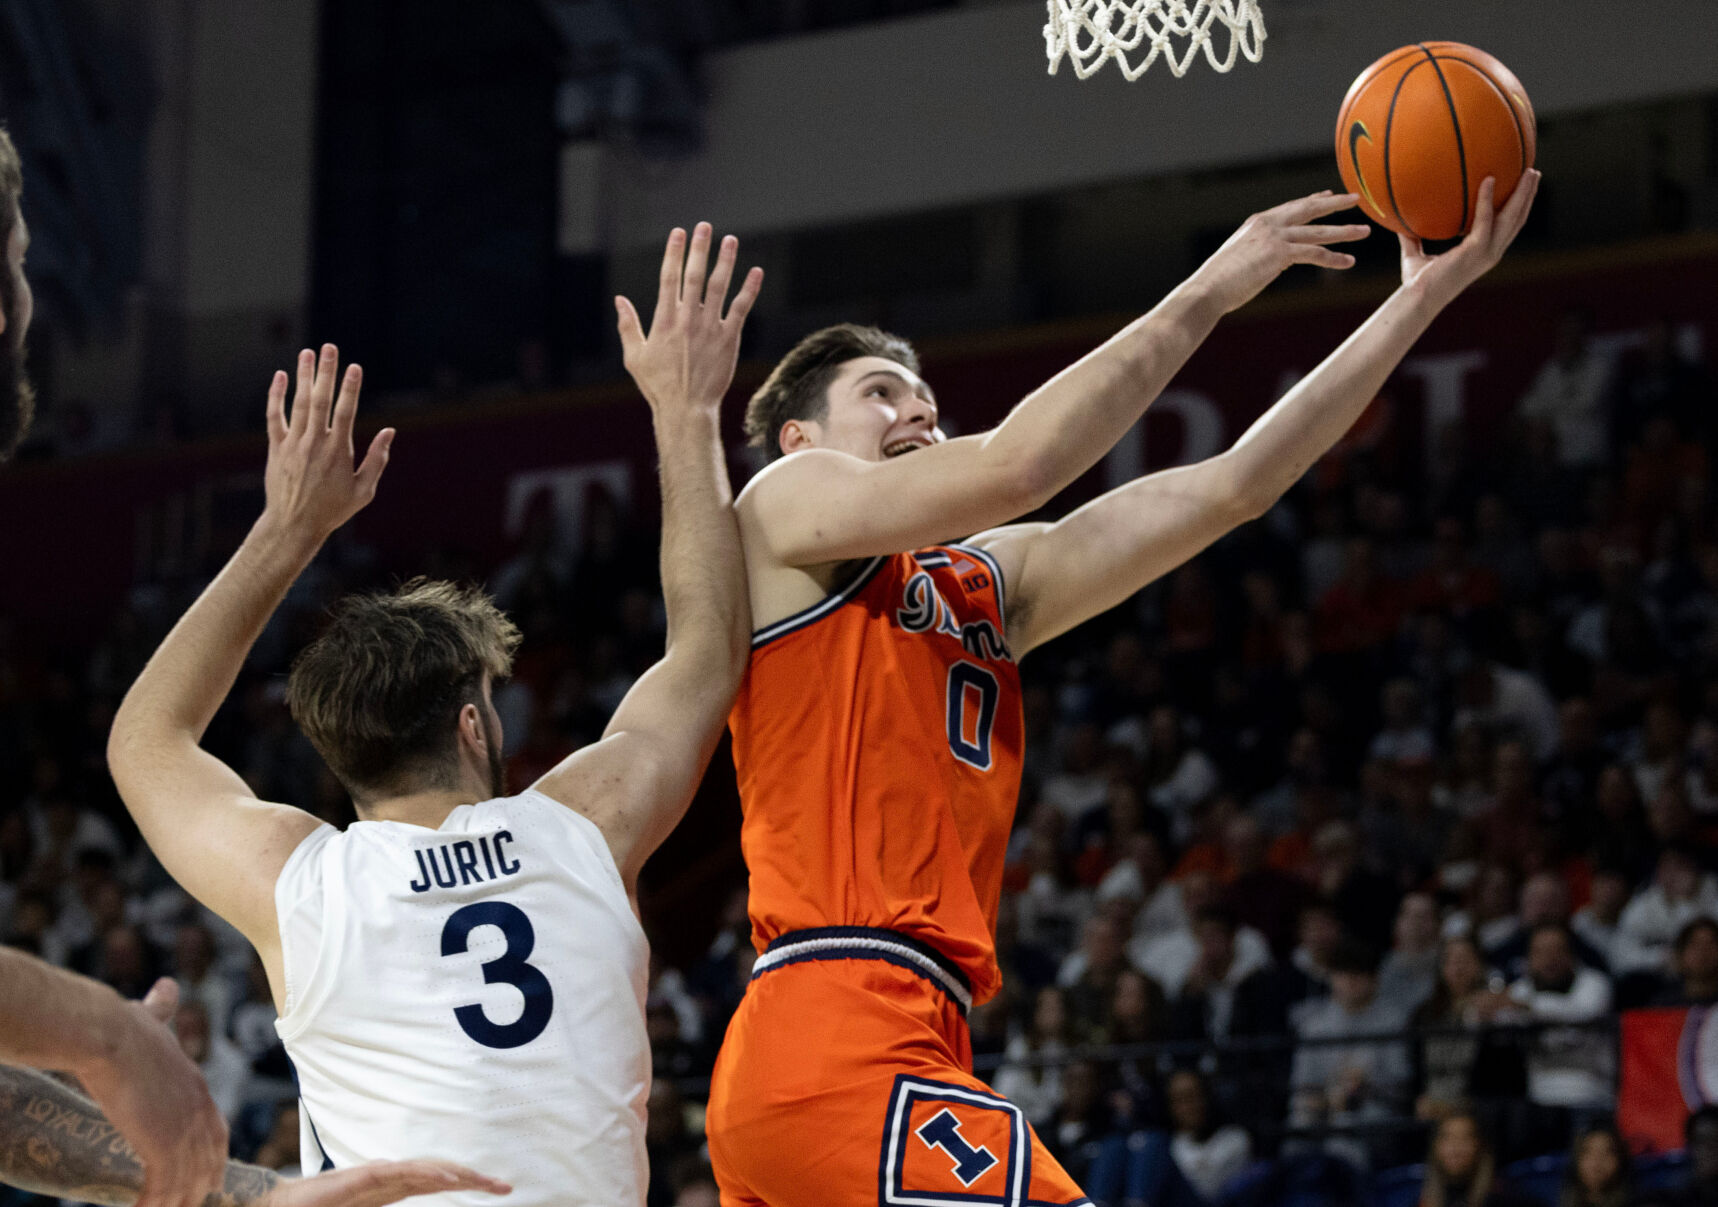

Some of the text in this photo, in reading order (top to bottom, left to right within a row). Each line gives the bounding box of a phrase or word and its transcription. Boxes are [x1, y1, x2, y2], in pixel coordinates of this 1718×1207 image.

[946, 659, 1000, 772] 0
[410, 830, 521, 893] JURIC
[441, 901, 554, 1049] 3
[914, 1107, 999, 1188] I
